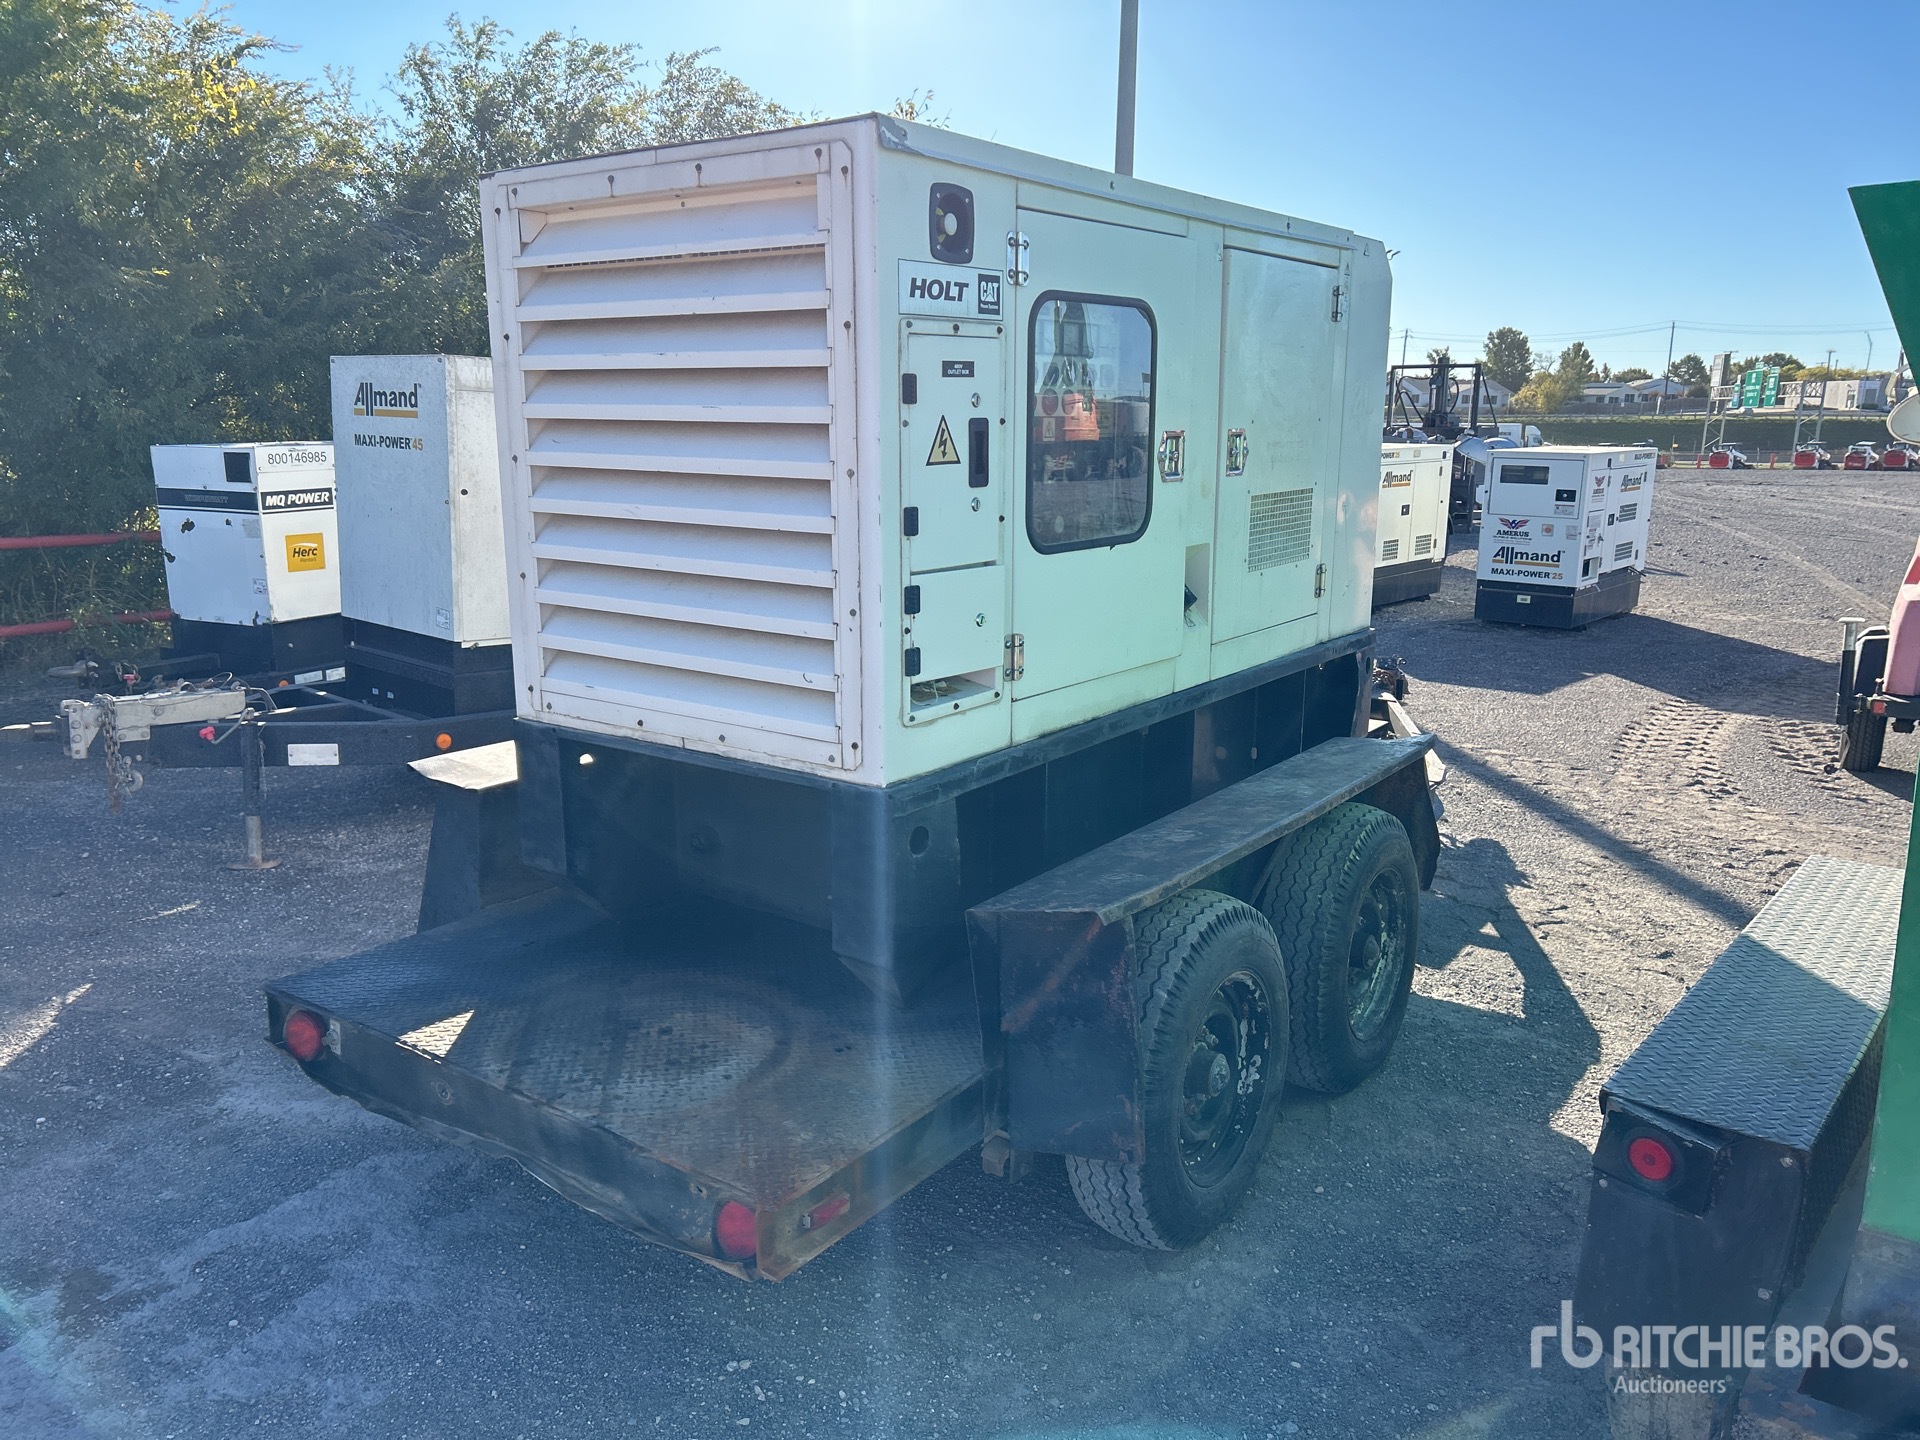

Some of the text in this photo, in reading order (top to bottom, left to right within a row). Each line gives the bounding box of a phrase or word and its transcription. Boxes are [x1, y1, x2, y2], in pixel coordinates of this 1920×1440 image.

[909, 277, 969, 302] HOLT
[980, 281, 999, 302] CAT
[354, 382, 418, 416] Allmand
[354, 433, 423, 451] MAXI-POWER 45
[267, 452, 327, 465] 800146985
[1383, 470, 1412, 488] Allmand
[1621, 473, 1643, 489] Allmand
[265, 491, 330, 507] MQ POWER
[292, 547, 318, 558] Herc
[1493, 546, 1561, 564] Allmand
[1491, 568, 1550, 579] MAXI-POWER
